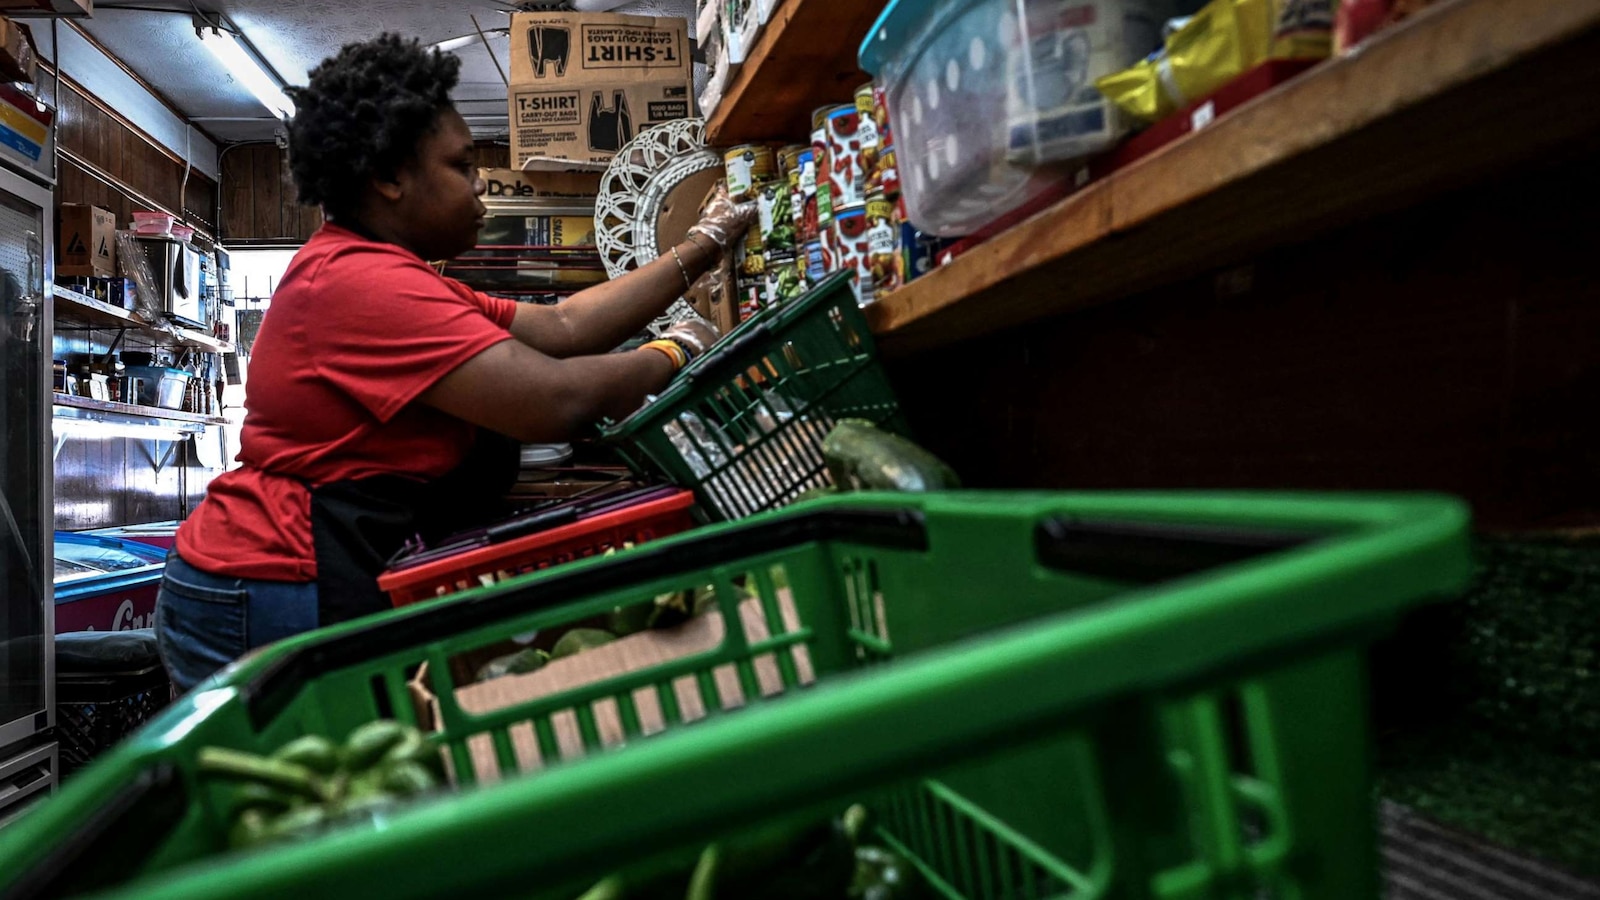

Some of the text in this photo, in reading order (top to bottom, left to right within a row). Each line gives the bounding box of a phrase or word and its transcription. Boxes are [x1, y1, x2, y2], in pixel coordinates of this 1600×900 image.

[618, 36, 672, 44] CARRY-OUT
[588, 45, 676, 61] T-SHIRT
[518, 96, 576, 110] T-SHIRT
[488, 180, 534, 196] Dole
